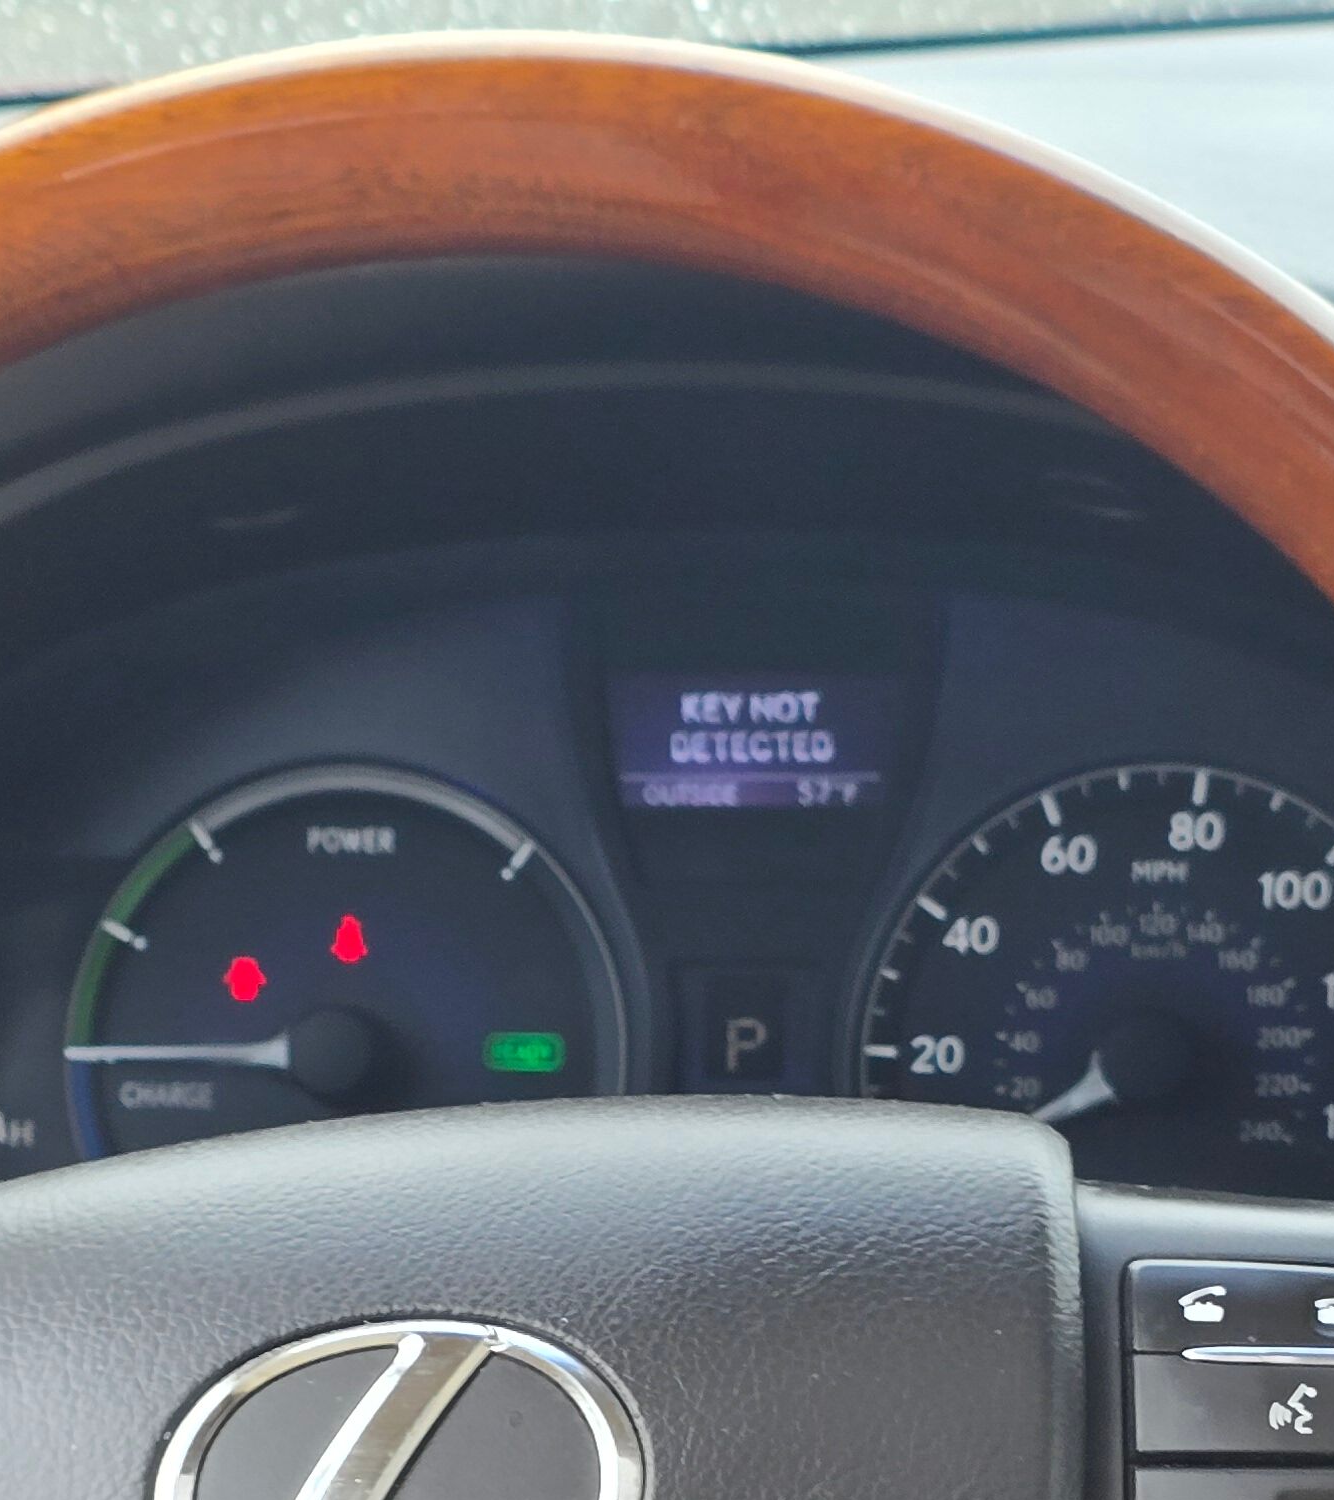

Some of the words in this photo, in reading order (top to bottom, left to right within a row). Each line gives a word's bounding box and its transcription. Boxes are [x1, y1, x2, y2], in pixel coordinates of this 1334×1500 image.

[680, 691, 742, 724] KEY
[748, 691, 822, 724] NOT
[670, 730, 835, 763] DETECTED
[306, 827, 396, 855] POWER
[1168, 812, 1225, 852] 80
[1040, 835, 1097, 874] 60
[1131, 860, 1190, 884] MPH
[1259, 870, 1333, 911] 100
[942, 916, 1000, 954] 40
[1090, 924, 1130, 946] 100
[1139, 913, 1179, 936] 120
[1186, 922, 1226, 945] 140
[726, 1017, 766, 1074] P
[910, 1036, 964, 1075] 20
[118, 1080, 214, 1110] CHARGE
